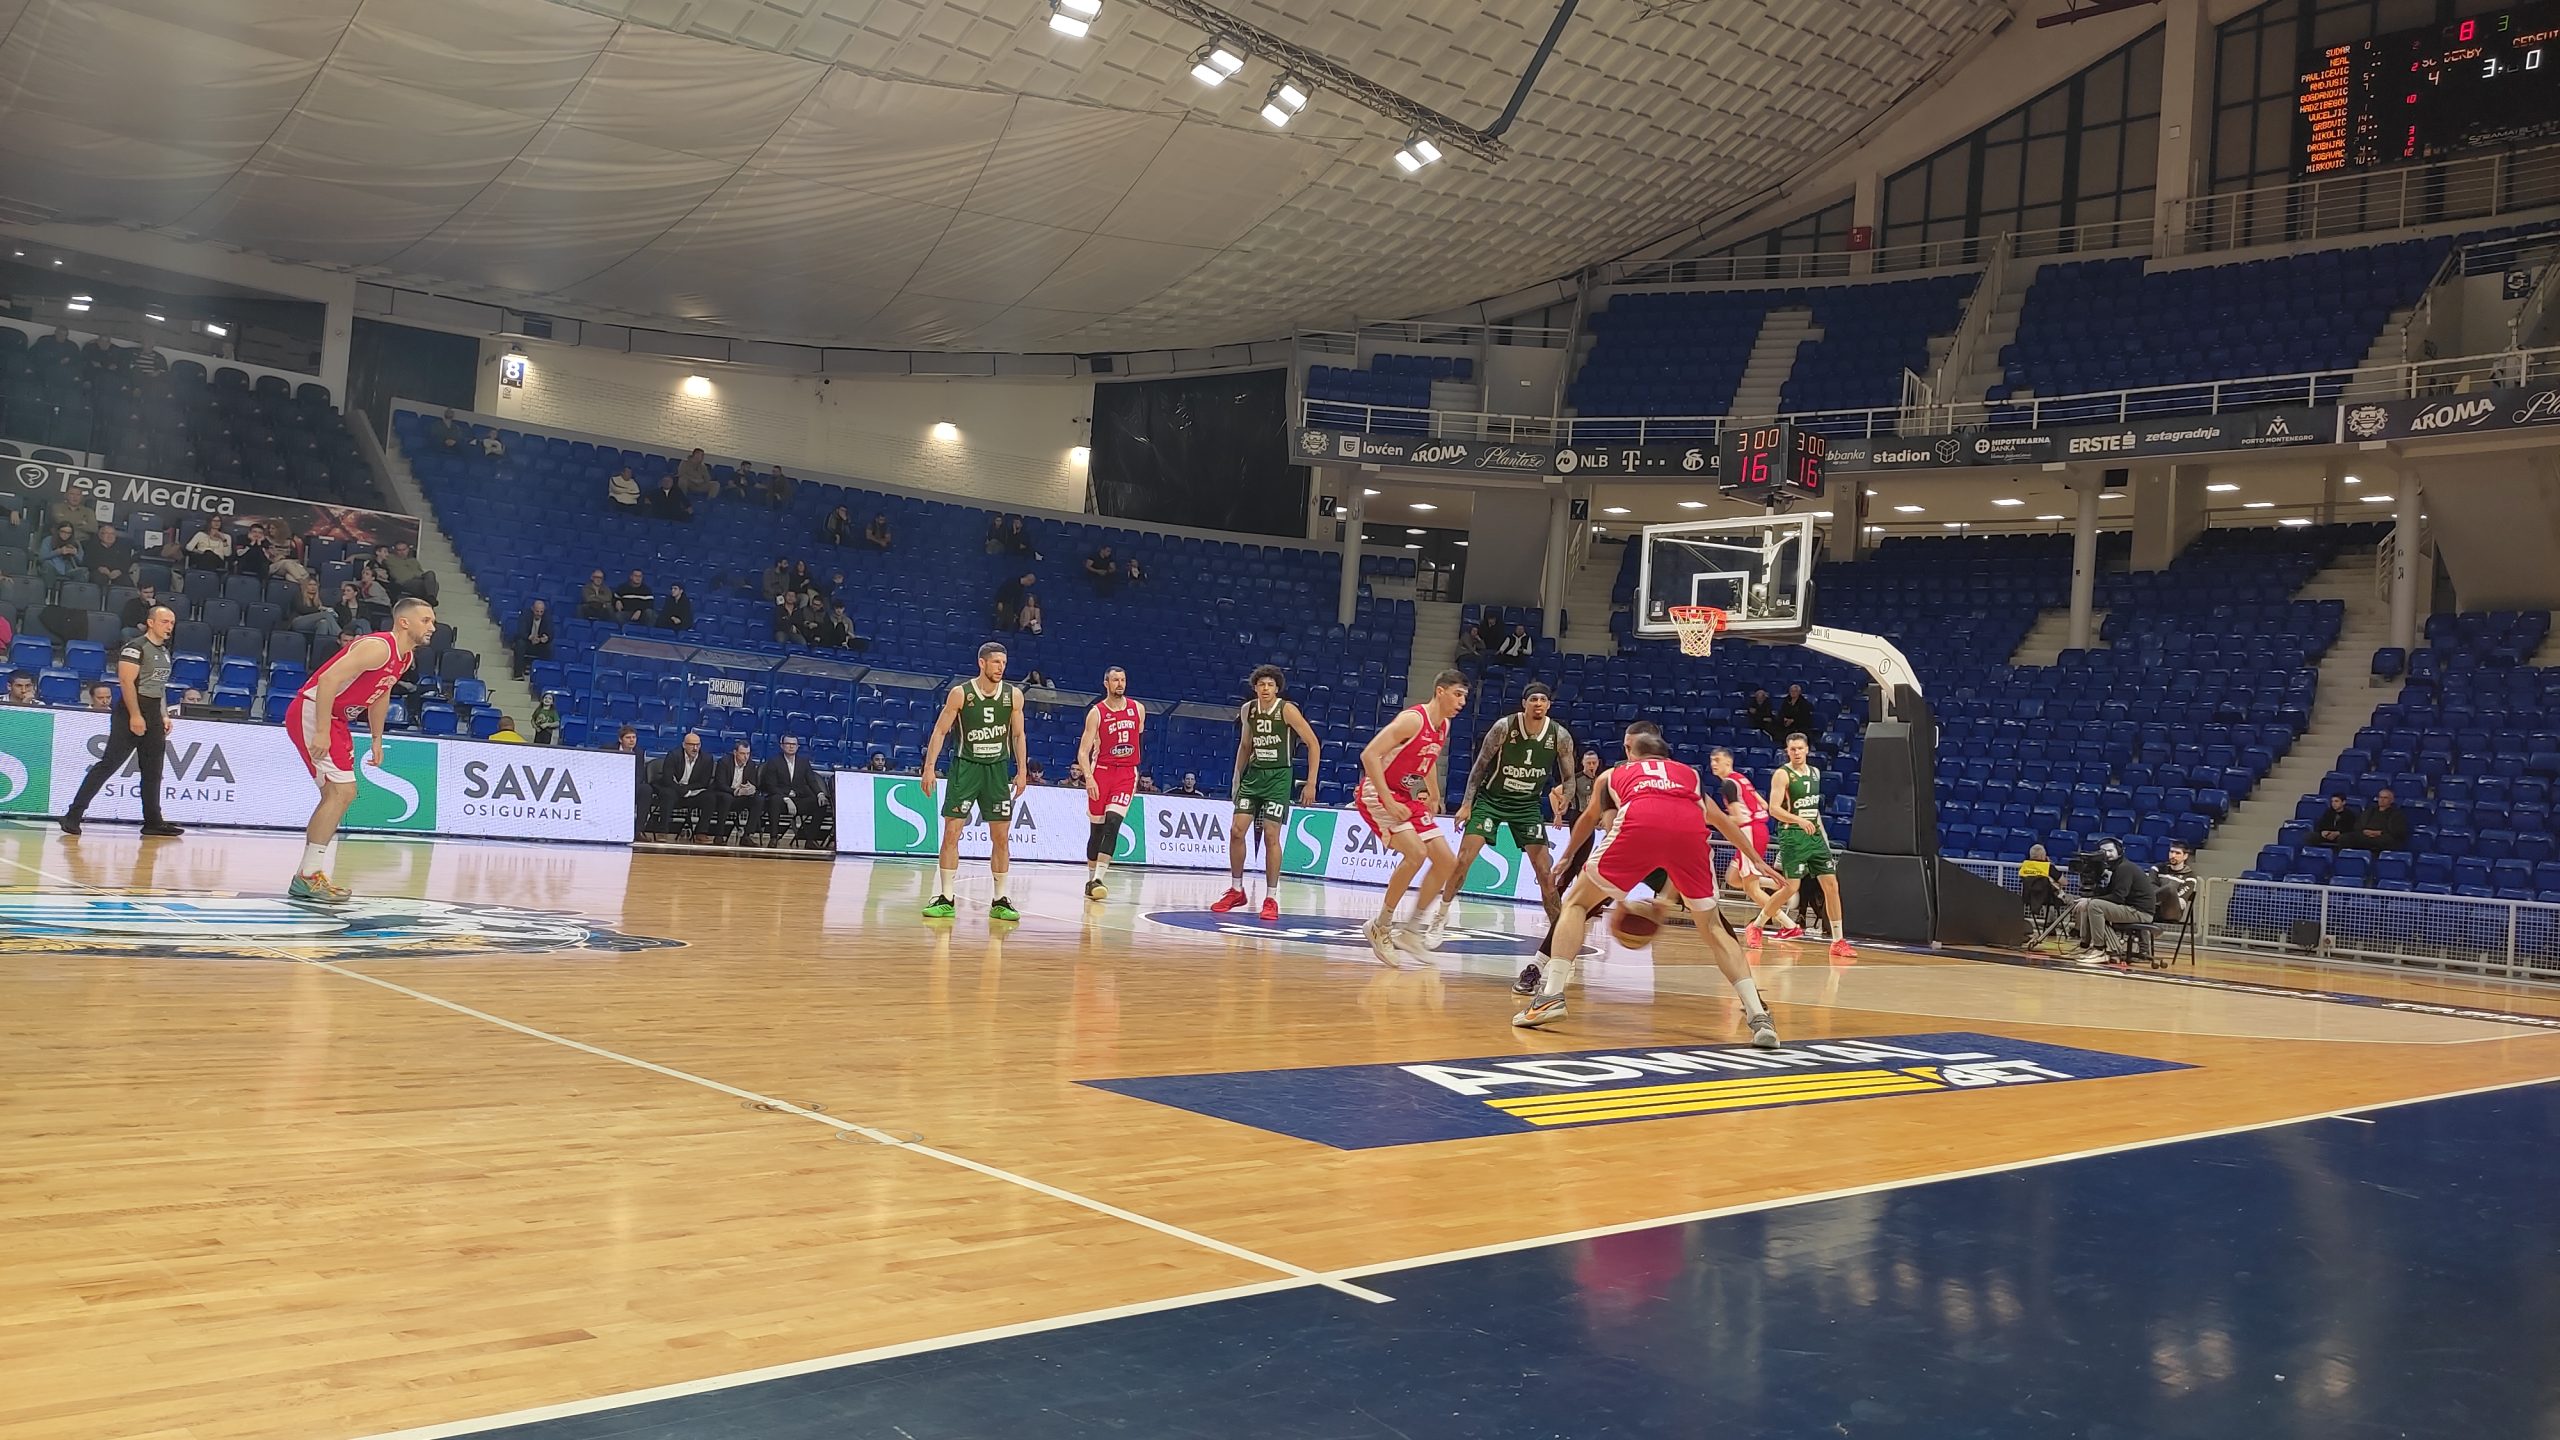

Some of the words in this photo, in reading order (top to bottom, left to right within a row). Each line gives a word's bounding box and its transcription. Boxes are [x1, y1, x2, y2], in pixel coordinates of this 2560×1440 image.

[2459, 20, 2474, 41] 8
[2325, 45, 2351, 58] SUDAR
[2329, 56, 2350, 67] NEAL
[2428, 70, 2440, 85] 4
[2312, 128, 2347, 142] NIKOLIC
[2305, 159, 2346, 174] MIRKOVIC
[506, 360, 521, 379] 8
[2410, 398, 2496, 431] AROMA
[1991, 436, 2051, 446] HIPOTEKARNA
[2144, 426, 2221, 443] zetagradnja
[2241, 437, 2265, 445] PORTO
[2265, 434, 2314, 444] MONTENEGRO
[1362, 441, 1403, 457] lovćen
[1990, 444, 2016, 452] BANKA
[2069, 434, 2122, 454] ERSTE
[1410, 443, 1468, 464] AROMA
[1580, 454, 1609, 469] NLB
[1872, 449, 1931, 464] stadion
[1741, 453, 1769, 483] 16
[1801, 457, 1819, 488] 16
[55, 467, 113, 500] Tea
[122, 478, 236, 516] Medica
[1323, 497, 1334, 511] 7
[1574, 500, 1585, 514] 7
[983, 706, 995, 724] 5
[966, 723, 1007, 742] CEDEVITA
[1108, 722, 1117, 734] SC
[1116, 719, 1136, 731] DERBY
[1256, 719, 1273, 733] 20
[1117, 730, 1130, 743] 19
[1111, 744, 1134, 755] derby
[1523, 748, 1533, 766] 1
[86, 734, 236, 784] SVA
[1502, 764, 1547, 778] CEDEVITA
[1640, 761, 1670, 782] 4
[463, 760, 582, 805] SAVA
[1803, 780, 1811, 794] 7
[104, 783, 236, 802] SIGRANJE
[1118, 792, 1131, 806] 19
[462, 802, 582, 821] OSIGURANJE
[1001, 800, 1011, 817] 5
[1266, 801, 1284, 818] 20
[1157, 808, 1226, 842] SAVA
[1535, 823, 1544, 840] 1
[959, 829, 1037, 844] OSIGANJE
[1344, 824, 1399, 857] SA
[1159, 841, 1227, 855] OSIGURANJE
[1341, 856, 1398, 870] OSIGURAN
[1397, 1039, 1998, 1096] ADMIRAL
